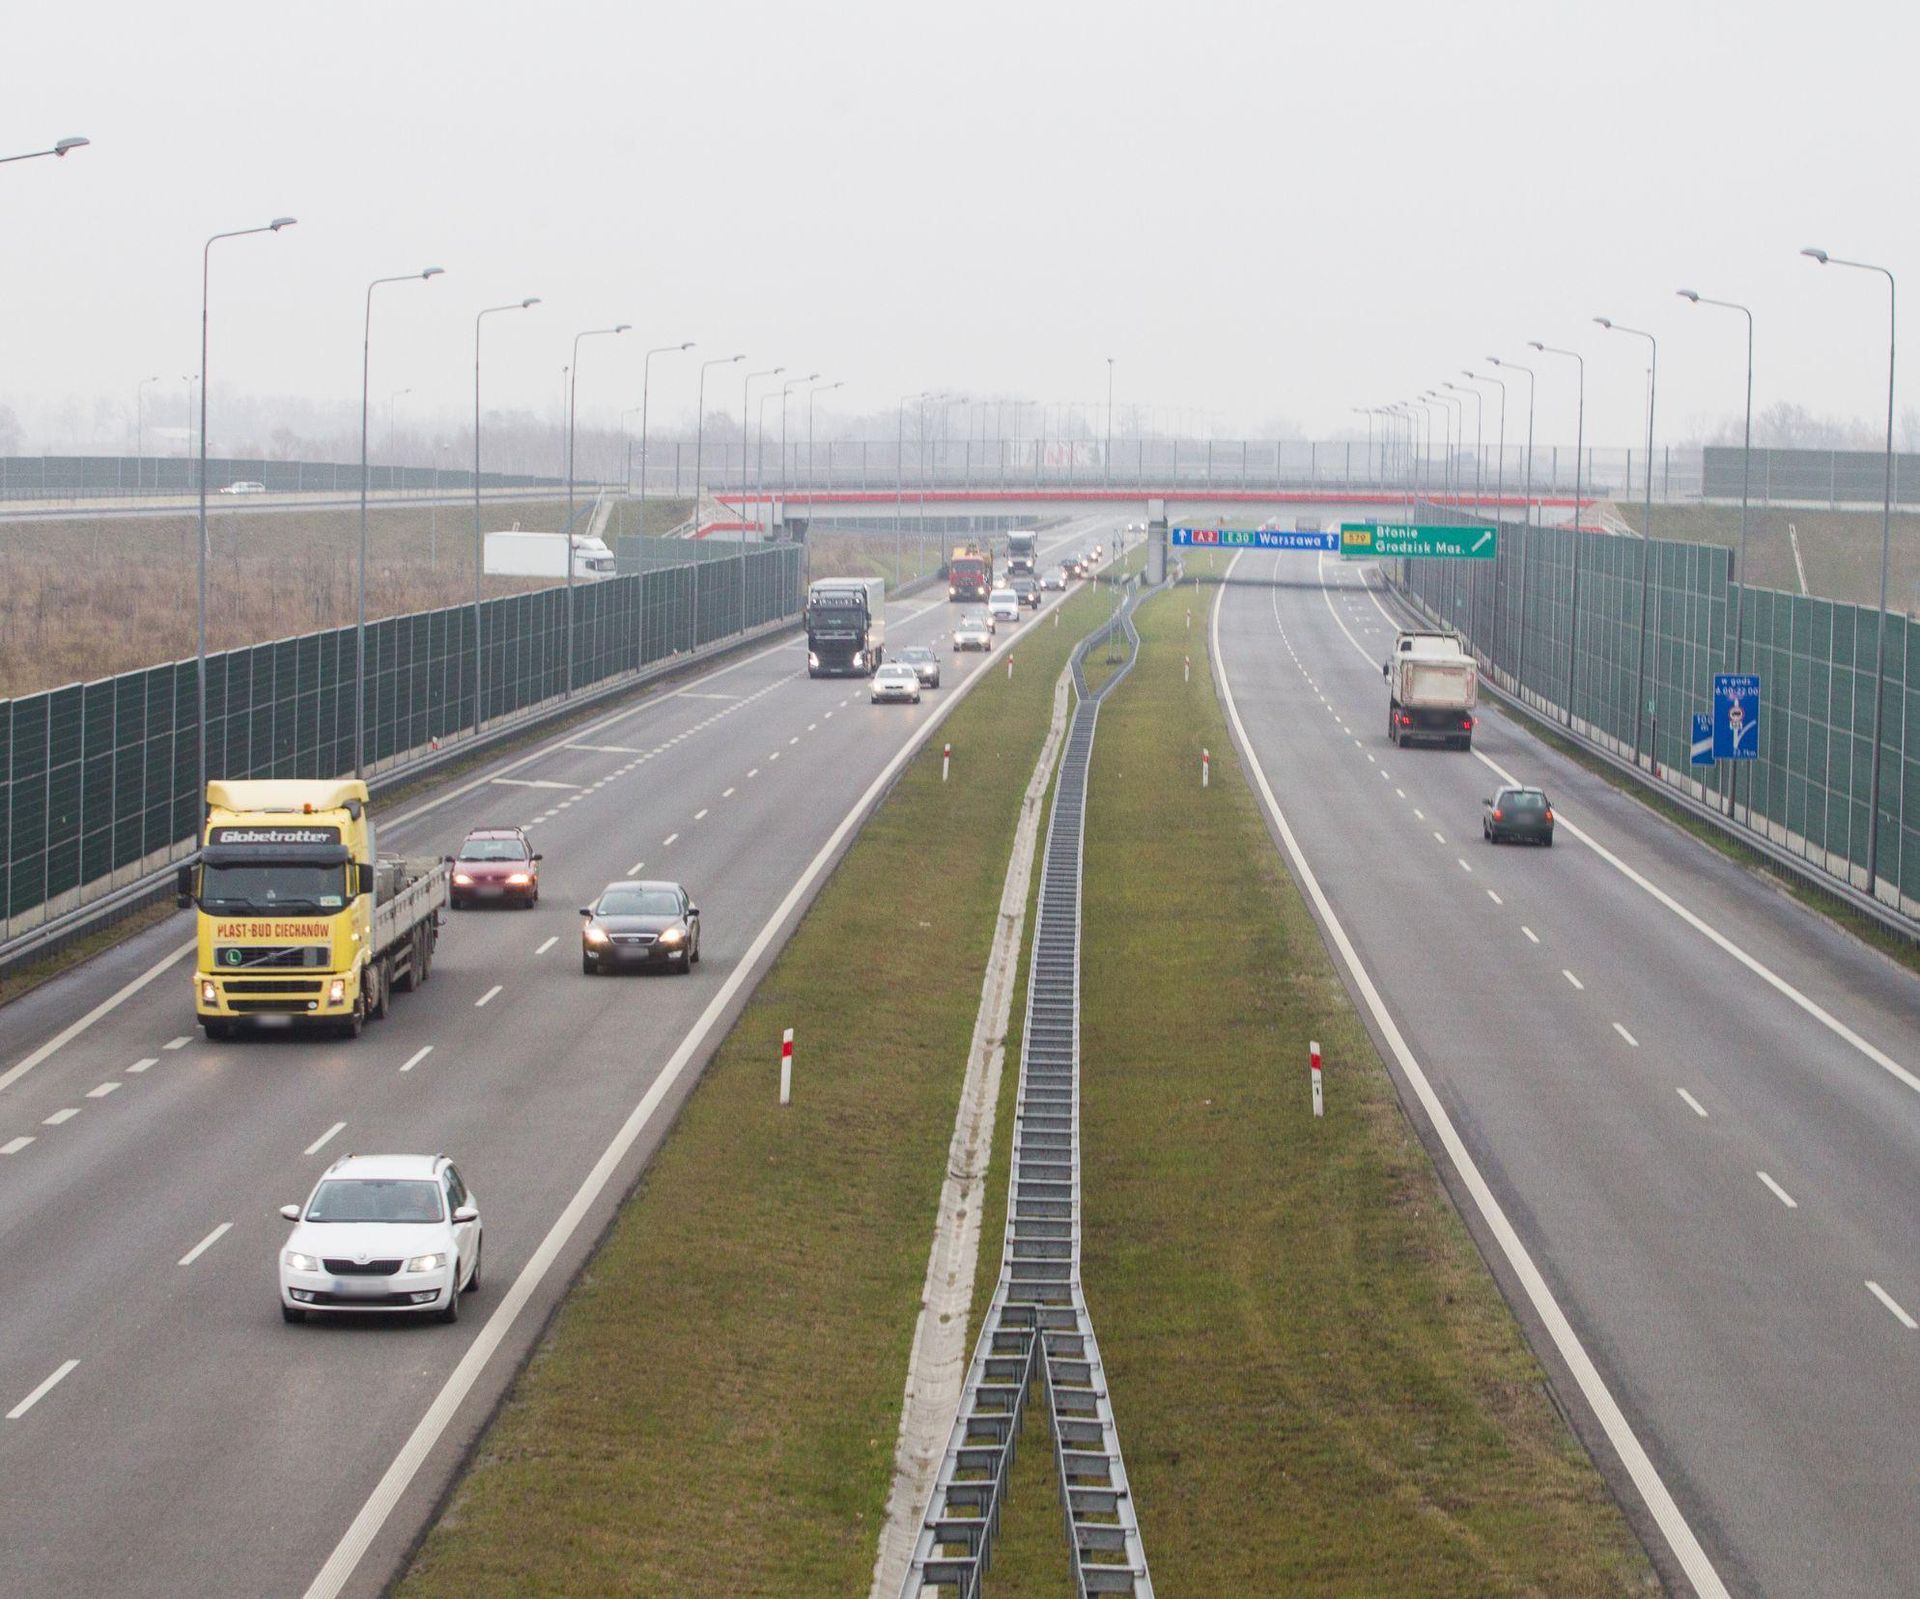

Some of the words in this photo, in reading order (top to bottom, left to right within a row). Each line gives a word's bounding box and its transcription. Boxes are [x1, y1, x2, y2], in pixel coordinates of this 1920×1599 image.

[1259, 532, 1321, 546] Warszawa
[1376, 526, 1418, 538] Błonie
[1375, 540, 1431, 553] Grodzisk
[1436, 542, 1465, 554] Maz.
[220, 830, 330, 843] Globetrotter
[218, 923, 271, 938] PLAST-BUD
[275, 921, 329, 938] CIECHANÓW
